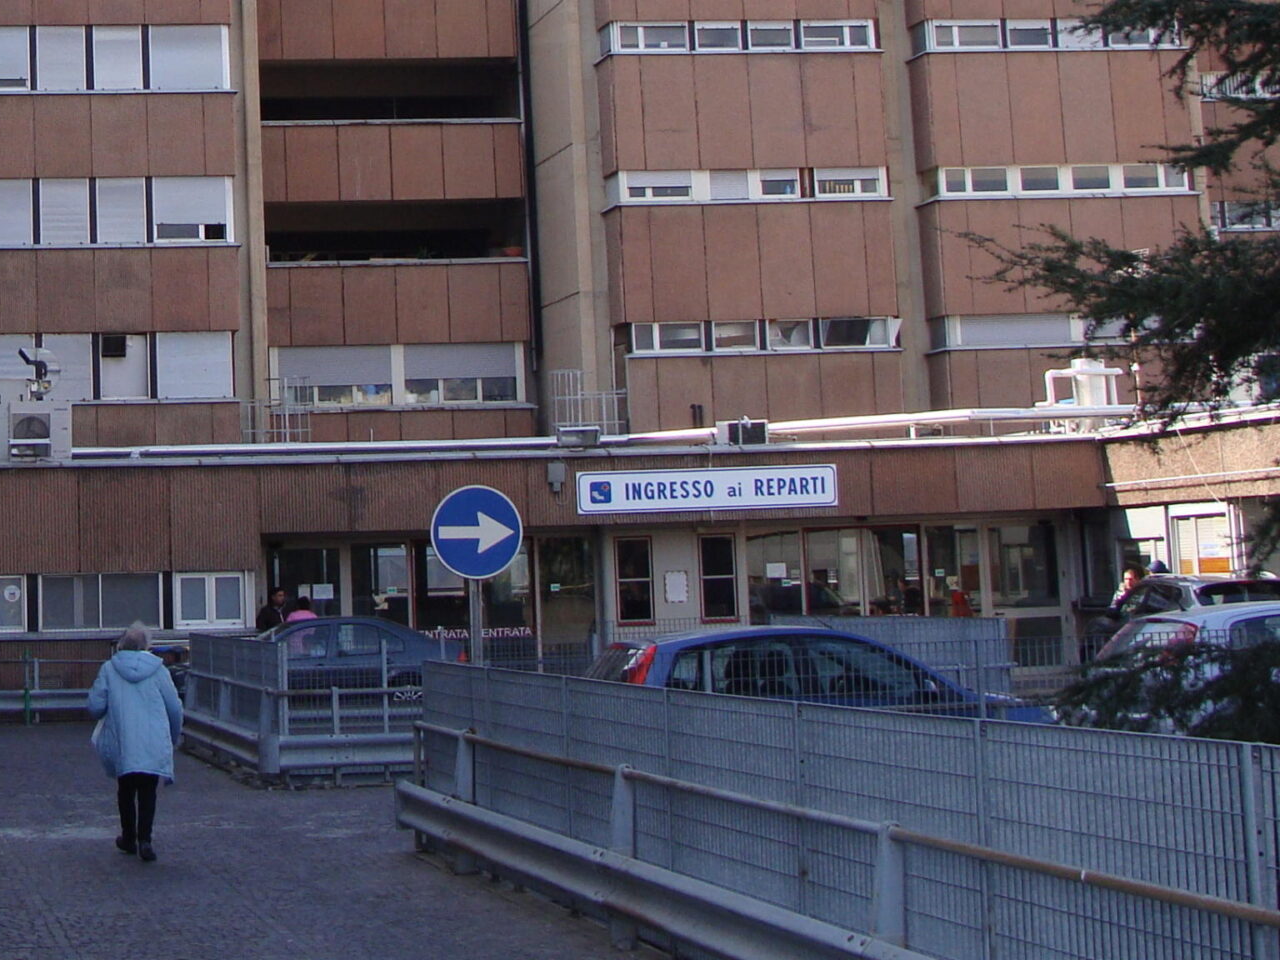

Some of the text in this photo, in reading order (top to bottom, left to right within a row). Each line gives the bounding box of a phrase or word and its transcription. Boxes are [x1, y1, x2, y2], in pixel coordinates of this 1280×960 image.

[624, 476, 826, 501] INGRESSO ai REPARTI
[419, 628, 469, 639] NTRATA
[481, 626, 533, 638] ENTRATA
